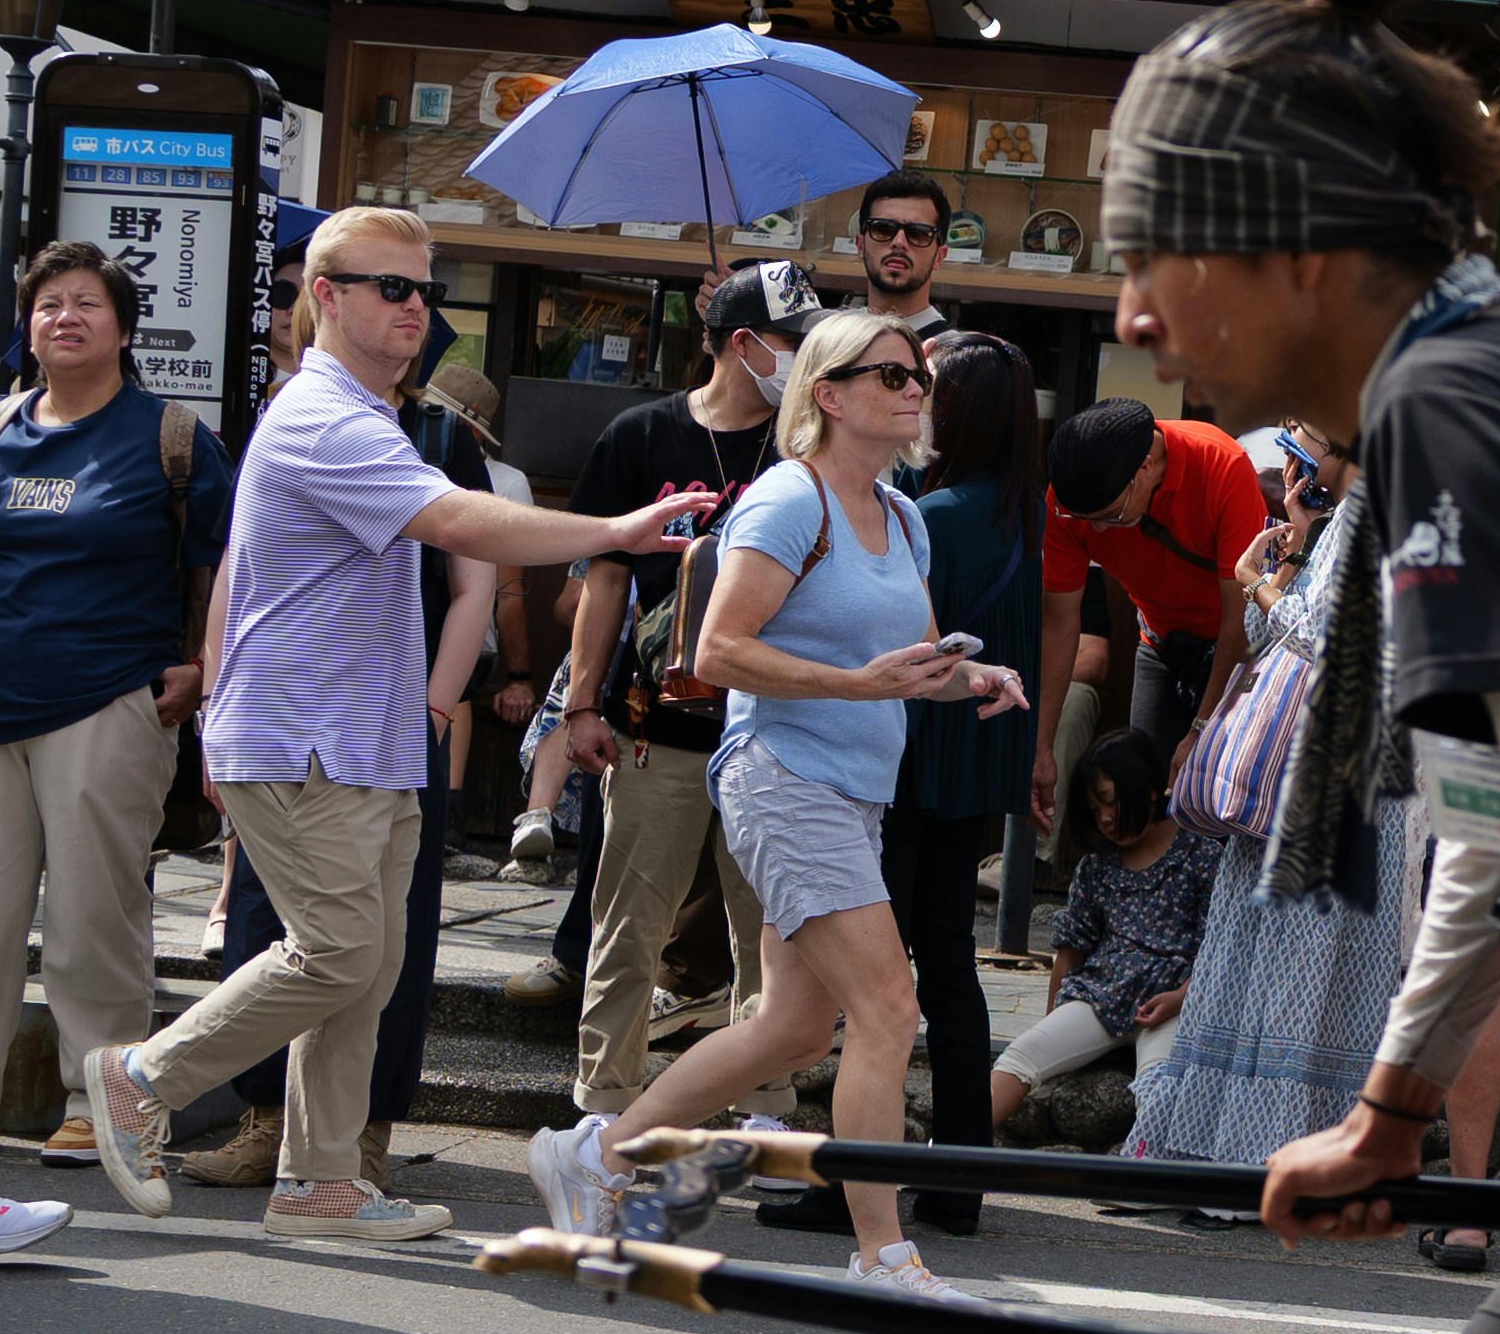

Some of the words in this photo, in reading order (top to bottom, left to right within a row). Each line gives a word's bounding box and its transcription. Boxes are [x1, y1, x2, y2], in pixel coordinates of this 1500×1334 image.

[105, 138, 155, 155] 市バス
[159, 141, 192, 157] City
[196, 143, 225, 158] Bus
[74, 168, 89, 179] 11
[107, 169, 125, 181] 28
[142, 171, 160, 183] 85
[178, 173, 195, 185] 93
[173, 210, 201, 307] Nonomiya
[149, 337, 176, 347] Next
[6, 477, 76, 514] VANS
